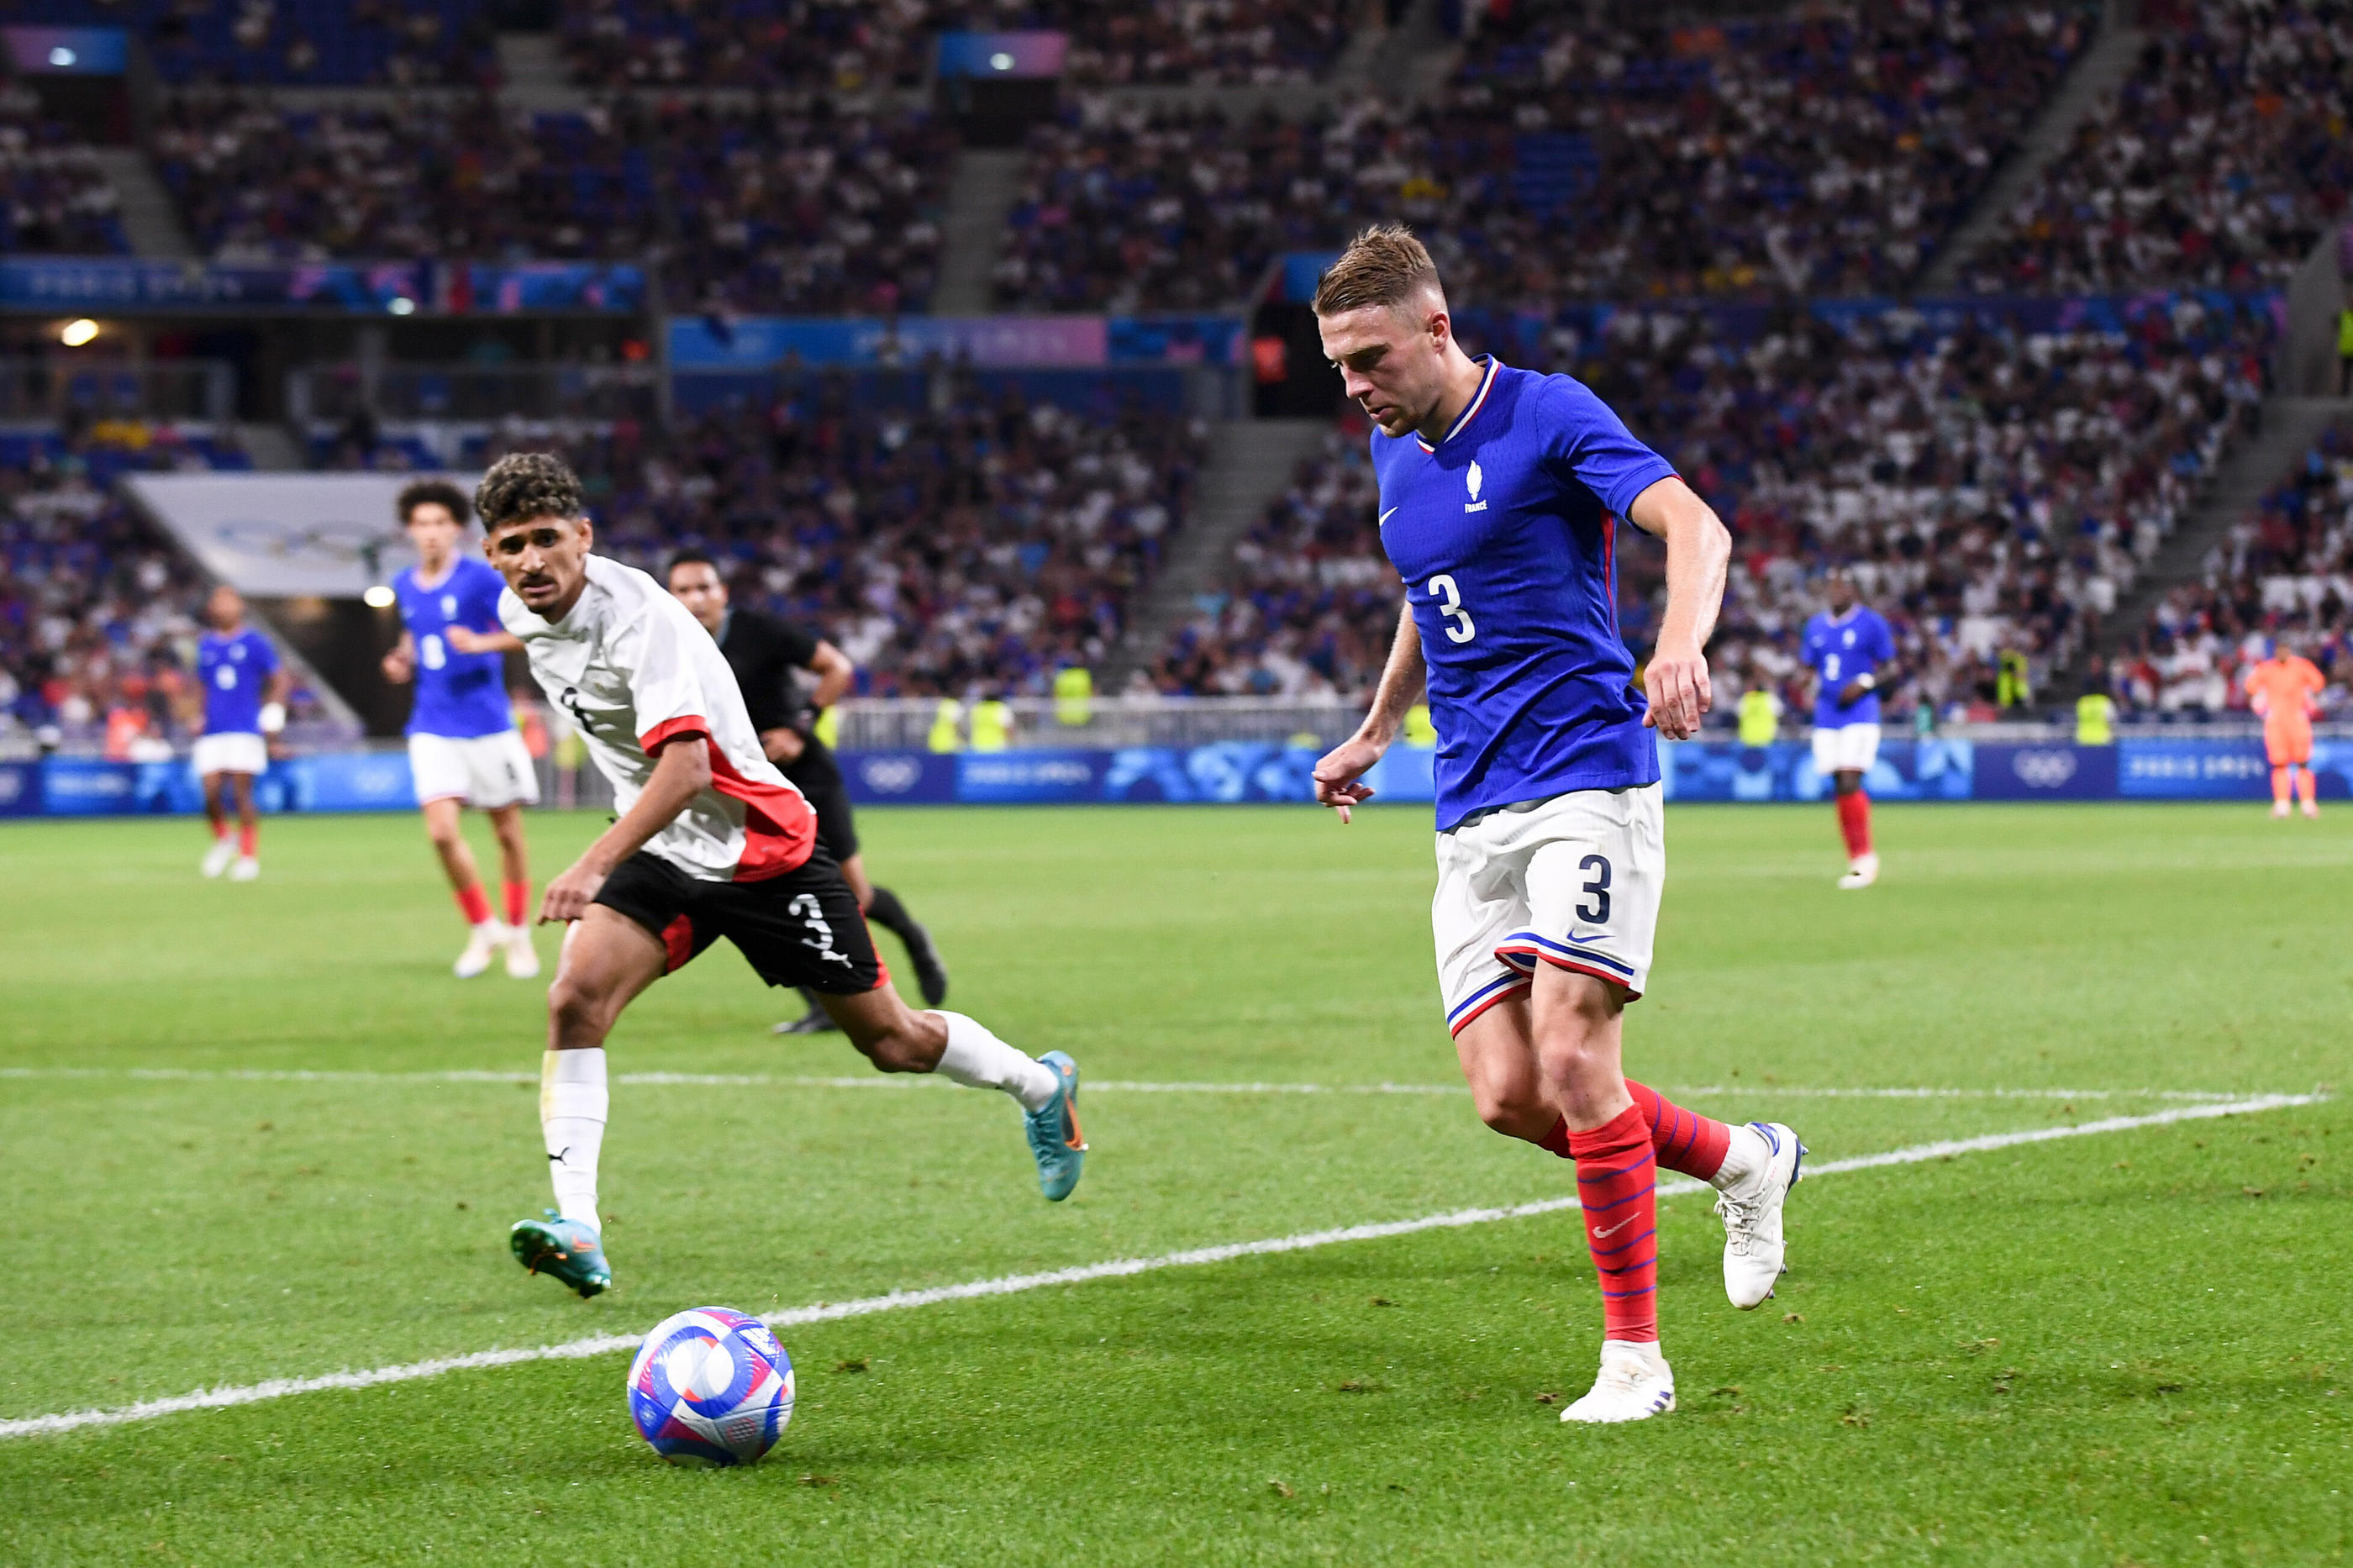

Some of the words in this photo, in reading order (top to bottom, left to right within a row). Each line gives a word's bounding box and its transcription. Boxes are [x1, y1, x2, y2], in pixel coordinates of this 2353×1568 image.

[1465, 499, 1487, 513] FRANCE
[1428, 574, 1475, 644] 3
[1576, 854, 1612, 924] 3
[788, 893, 834, 950] 3
